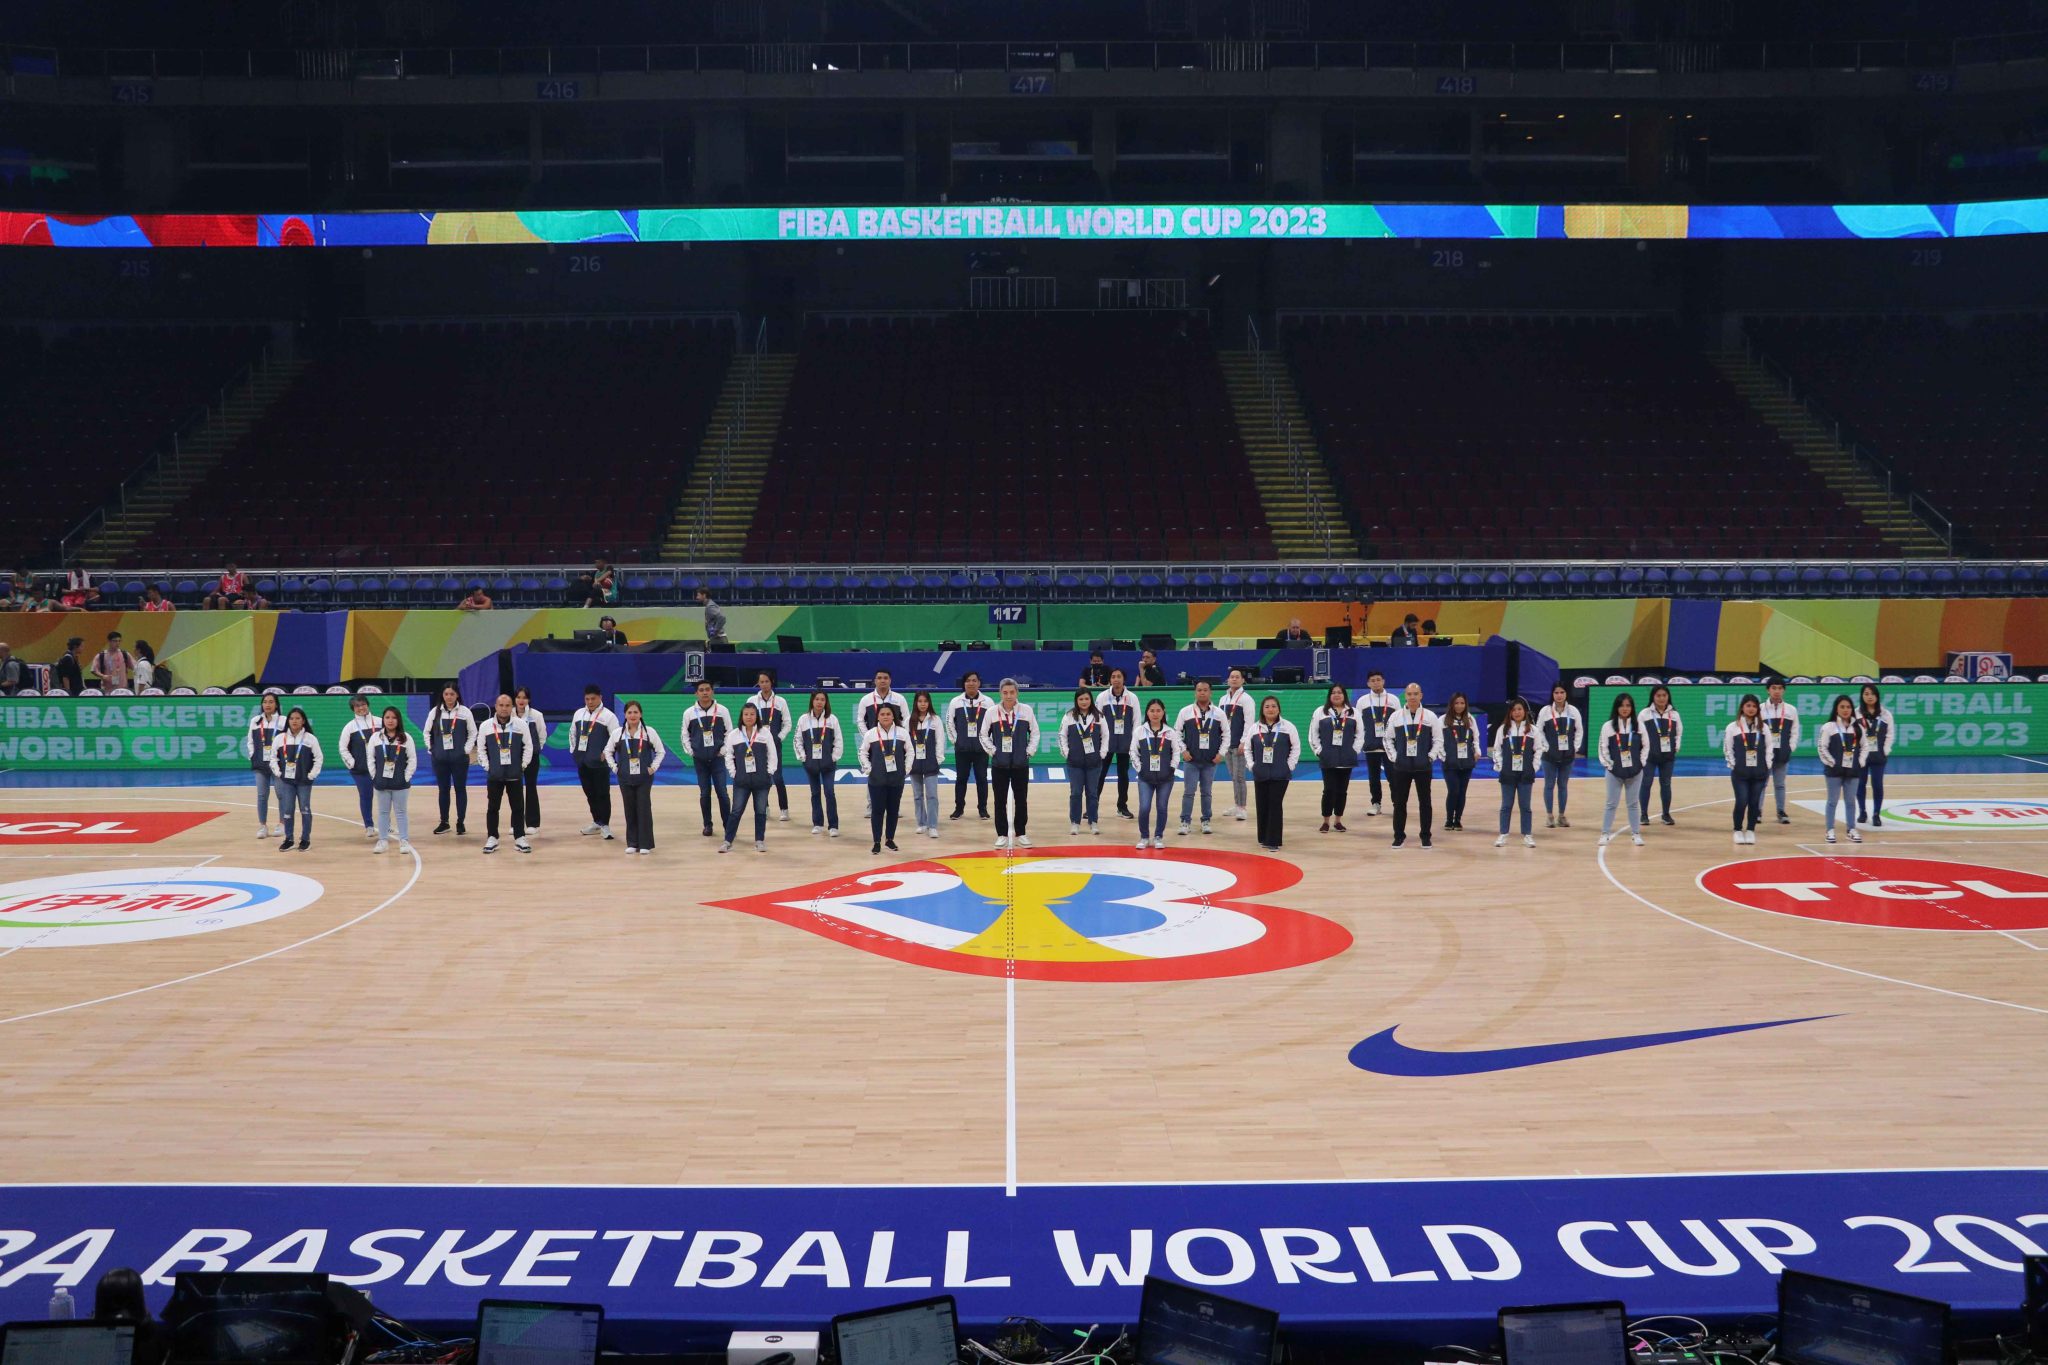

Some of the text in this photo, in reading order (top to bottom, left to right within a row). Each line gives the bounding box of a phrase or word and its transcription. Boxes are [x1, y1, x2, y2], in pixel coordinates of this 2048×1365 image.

[542, 81, 575, 98] 416
[1014, 76, 1047, 93] 417
[1440, 77, 1473, 94] 418
[1917, 75, 1949, 92] 419
[117, 86, 150, 104] 415
[778, 207, 1327, 238] FIBA BASKETBALL WORLD CUP 2023
[569, 256, 601, 272] 216
[1433, 251, 1464, 267] 218
[1912, 249, 1943, 267] 219
[120, 260, 151, 277] 215
[993, 607, 1022, 621] 117
[1797, 692, 2033, 716] BETBALL
[0, 706, 69, 728] IBA
[1933, 722, 2030, 747] 2023
[131, 735, 206, 761] CUP
[0, 821, 140, 835] CL
[1732, 880, 2048, 901] TCL
[0, 893, 237, 913] 伊利
[138, 1228, 1012, 1288] BASKETBALL
[1052, 1224, 1523, 1287] WORLD
[1556, 1217, 1818, 1276] CUP
[1842, 1213, 2048, 1273] 20
